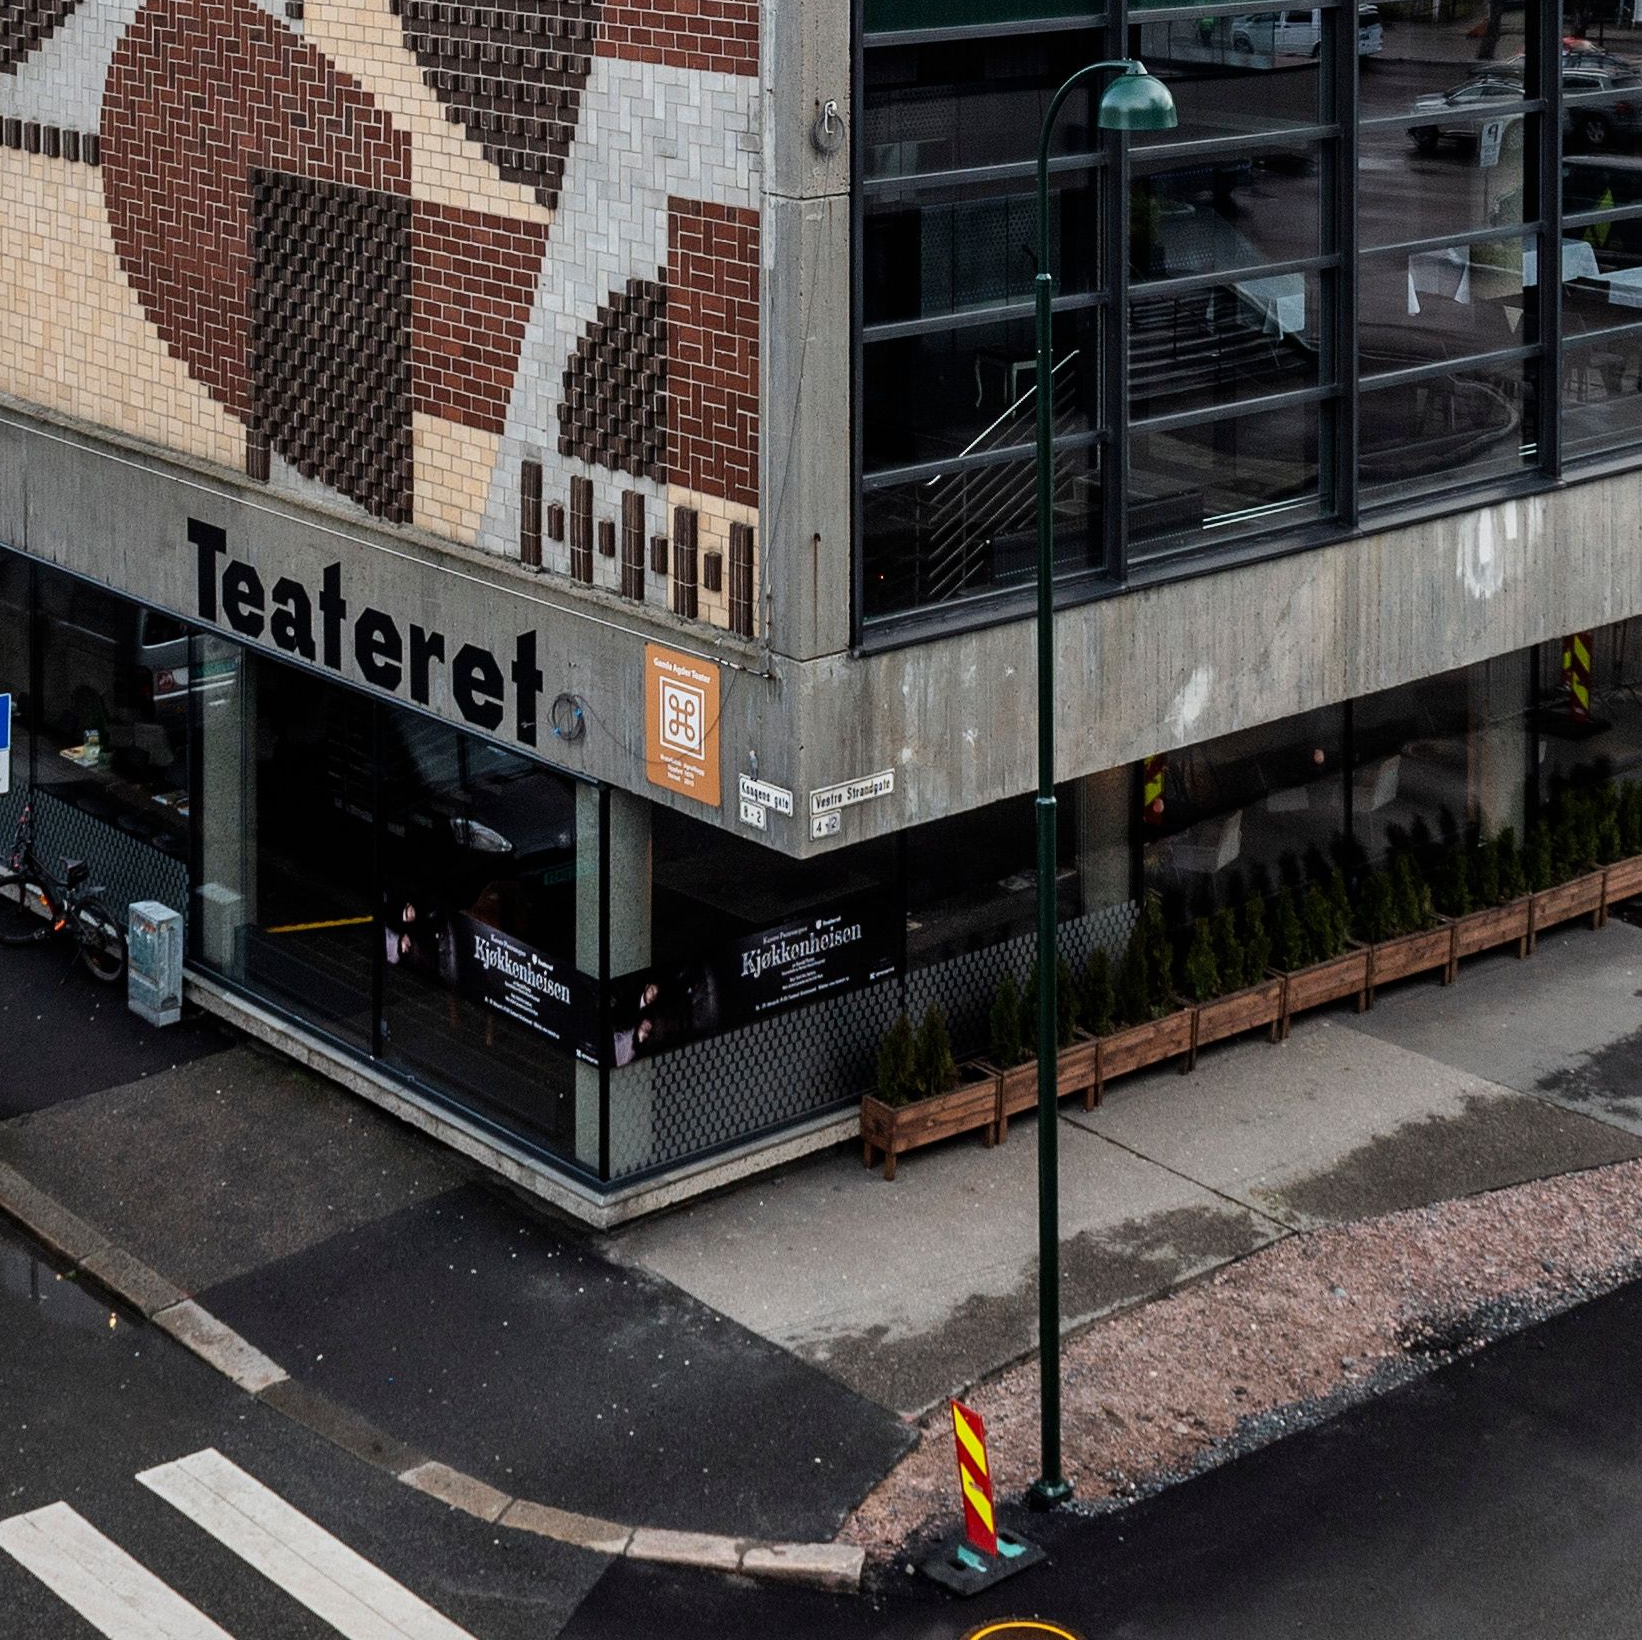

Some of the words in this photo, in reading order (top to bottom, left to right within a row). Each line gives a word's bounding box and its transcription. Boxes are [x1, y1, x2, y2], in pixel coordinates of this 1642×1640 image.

[187, 517, 544, 748] Teateret
[816, 793, 843, 809] Vestre
[847, 779, 891, 800] Strandgate
[474, 935, 571, 1005] Kjøkkenheisen
[741, 923, 863, 978] Kjøkkenheisen
